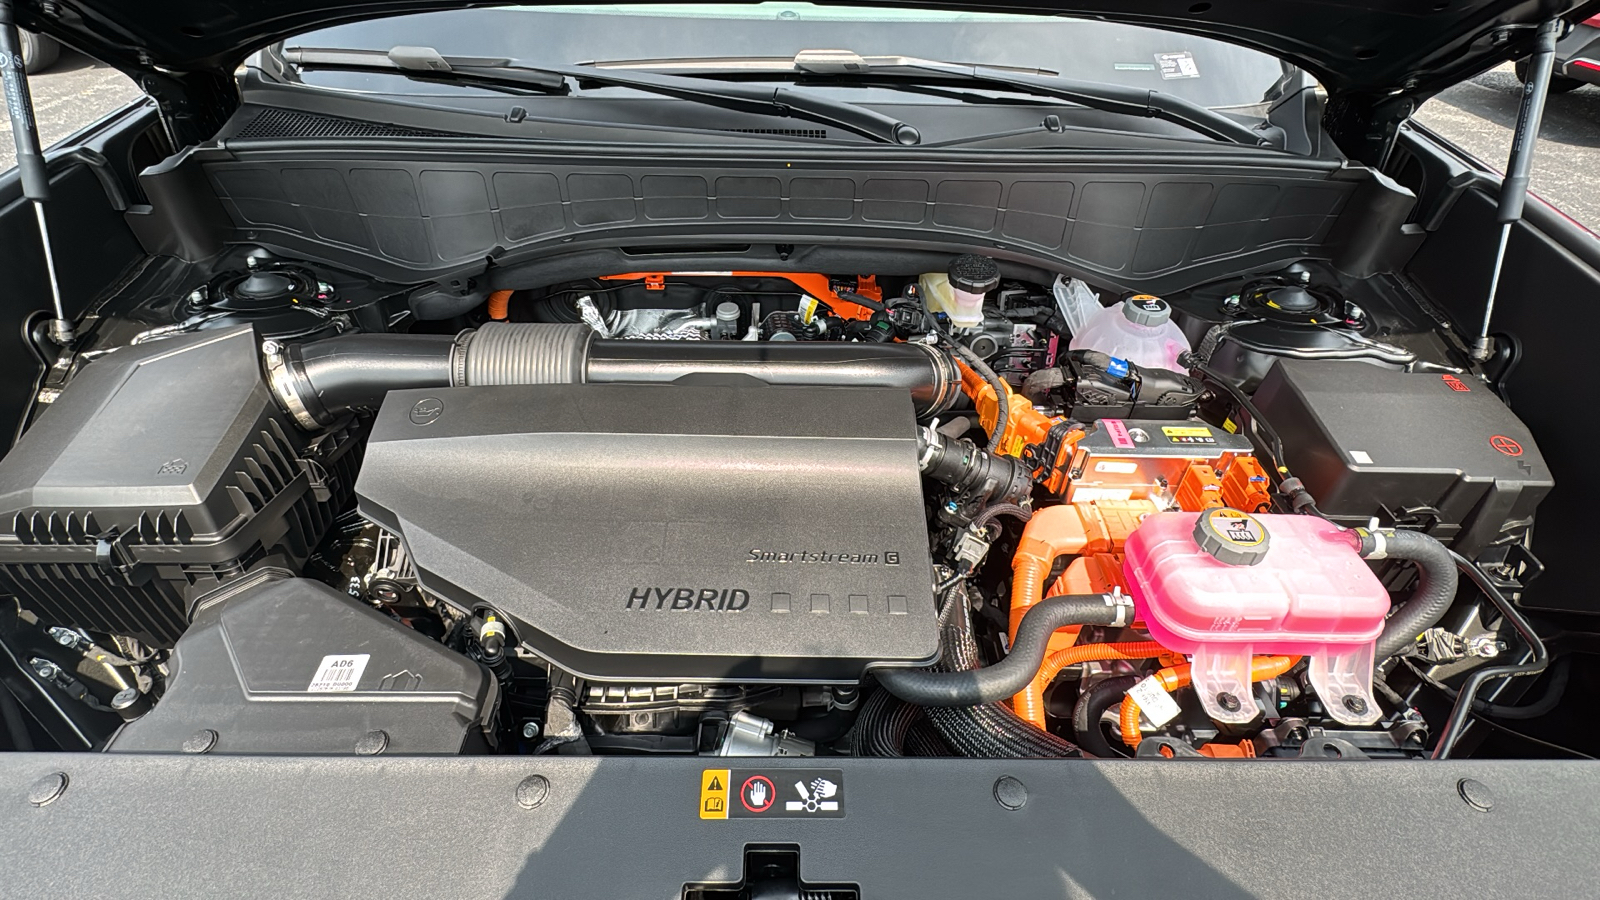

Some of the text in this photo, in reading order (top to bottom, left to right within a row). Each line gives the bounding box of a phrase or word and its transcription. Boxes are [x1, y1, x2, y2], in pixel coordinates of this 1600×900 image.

[746, 549, 900, 565] Smartstream G
[348, 576, 361, 597] 533
[625, 587, 750, 612] HYBRID
[330, 660, 354, 668] AD6
